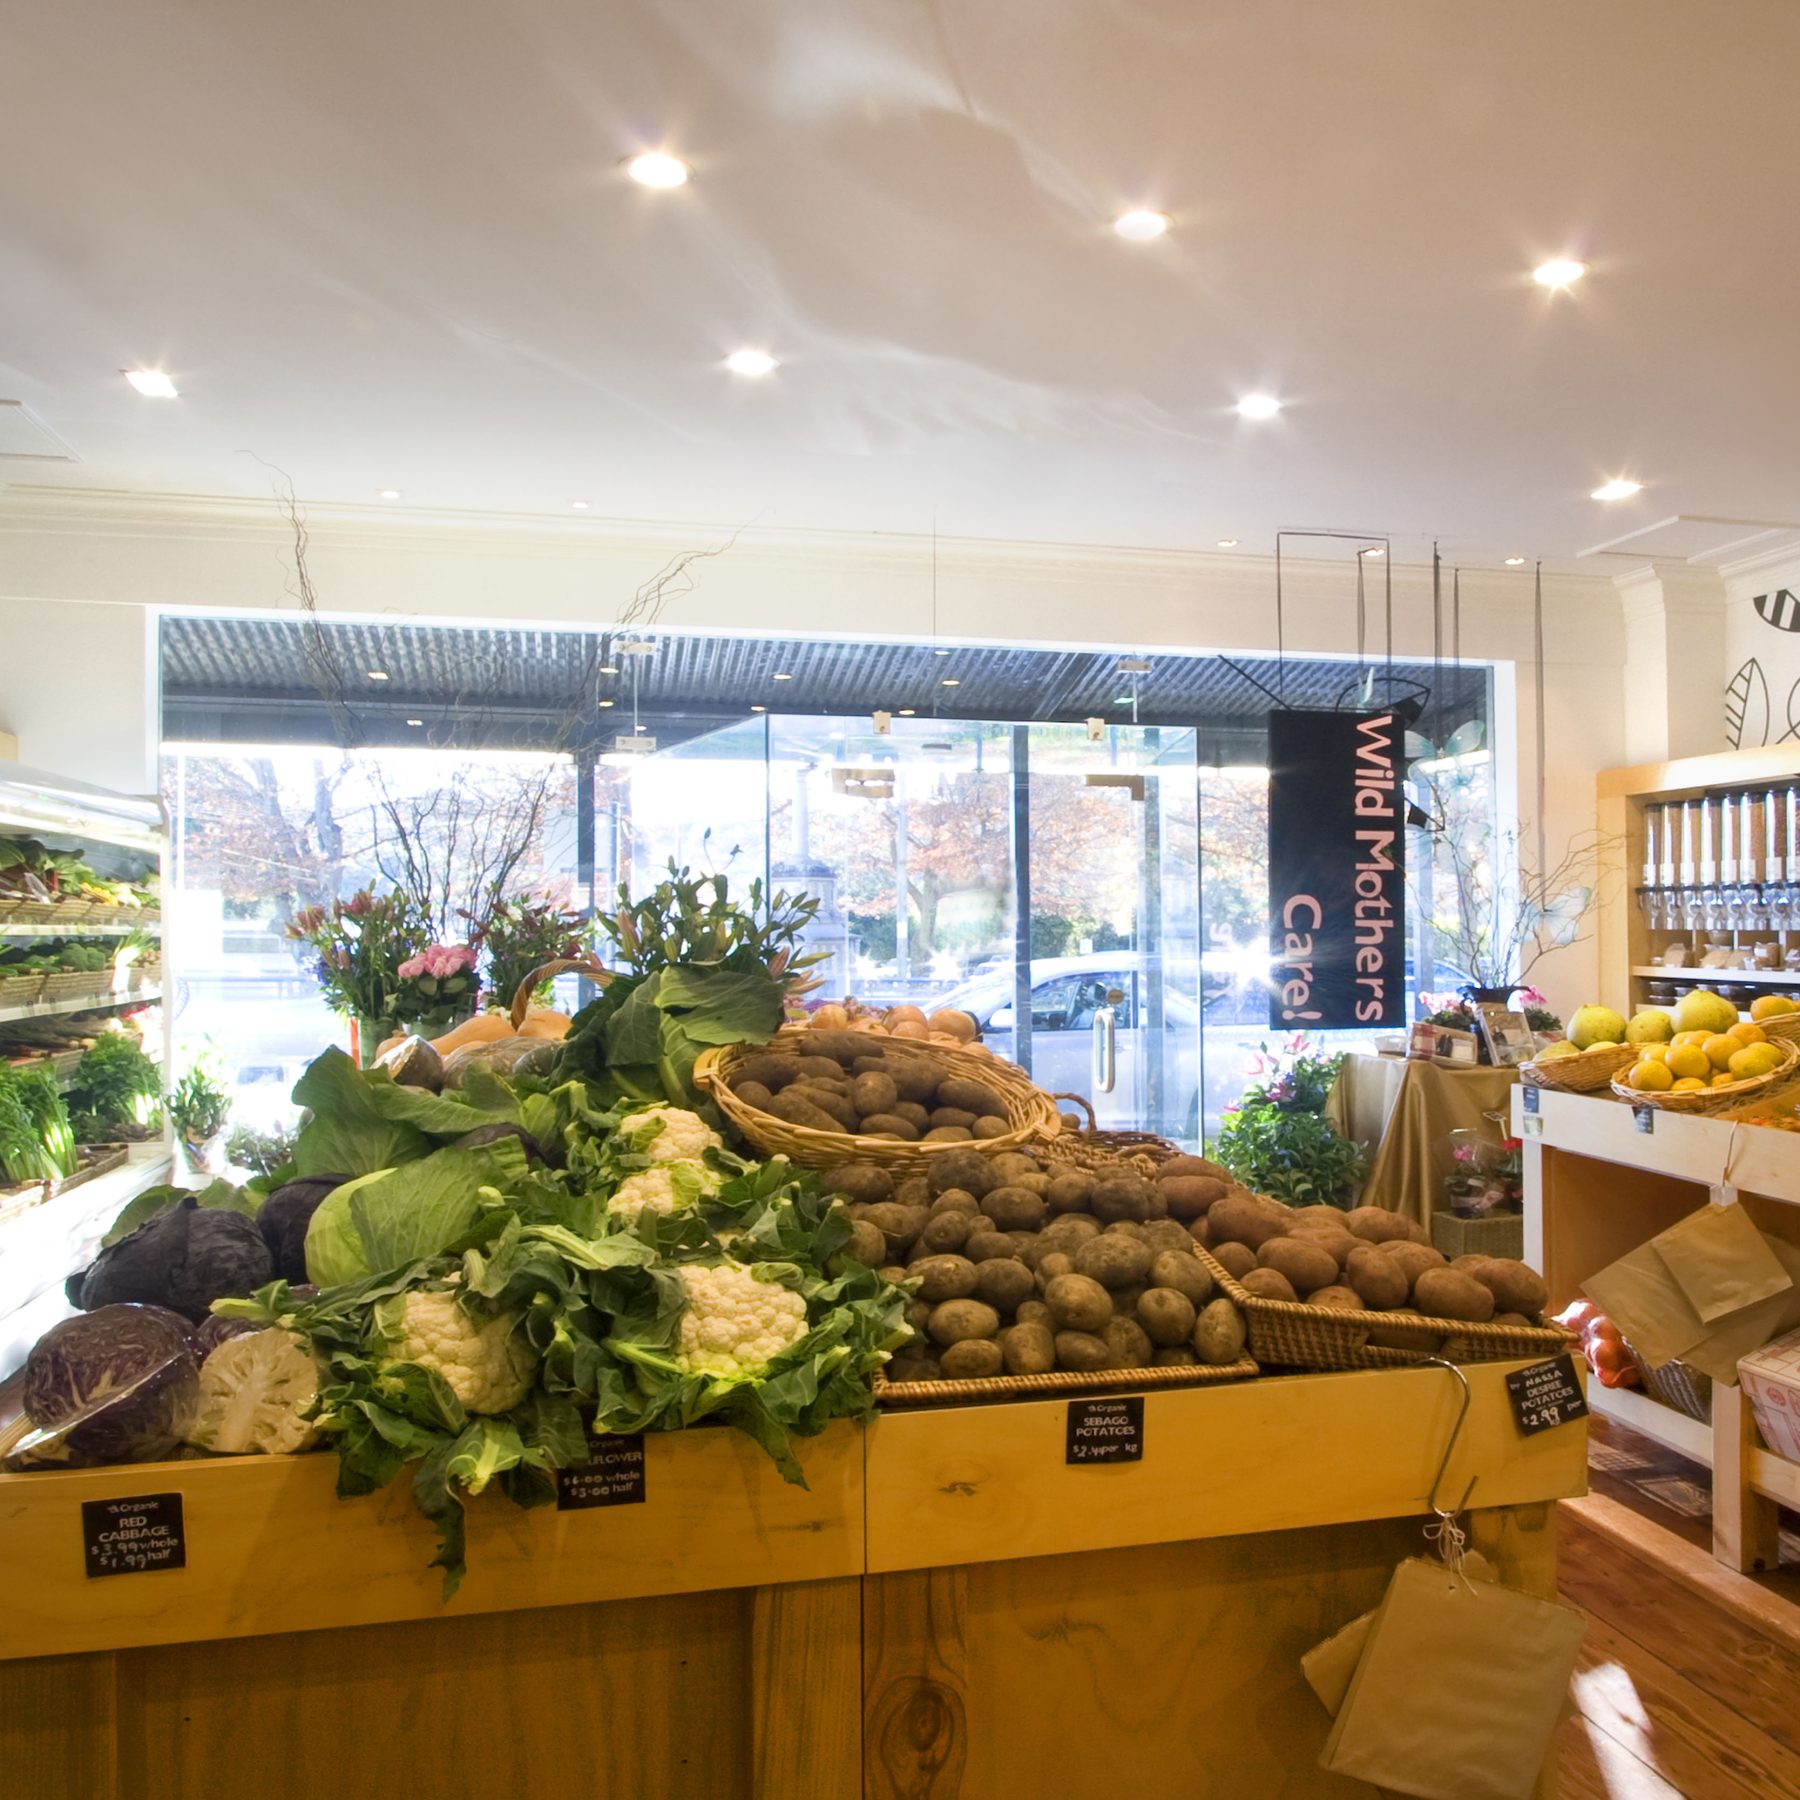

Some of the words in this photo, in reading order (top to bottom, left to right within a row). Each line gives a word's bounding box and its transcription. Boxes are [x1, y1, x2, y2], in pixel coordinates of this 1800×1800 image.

[1354, 714, 1395, 818] Wild
[1354, 830, 1395, 1022] Mothers
[1281, 893, 1323, 1021] Care!
[1521, 1386, 1574, 1410] POTATOES
[1083, 1416, 1129, 1427] SEBAGO
[1076, 1426, 1136, 1437] POTATOES
[606, 1471, 640, 1482] whole
[612, 1482, 634, 1493] half
[119, 1501, 159, 1513] Organic
[119, 1516, 148, 1529] RED
[98, 1525, 170, 1542] CABBAGE
[139, 1536, 179, 1549] whole
[147, 1549, 171, 1561] half
